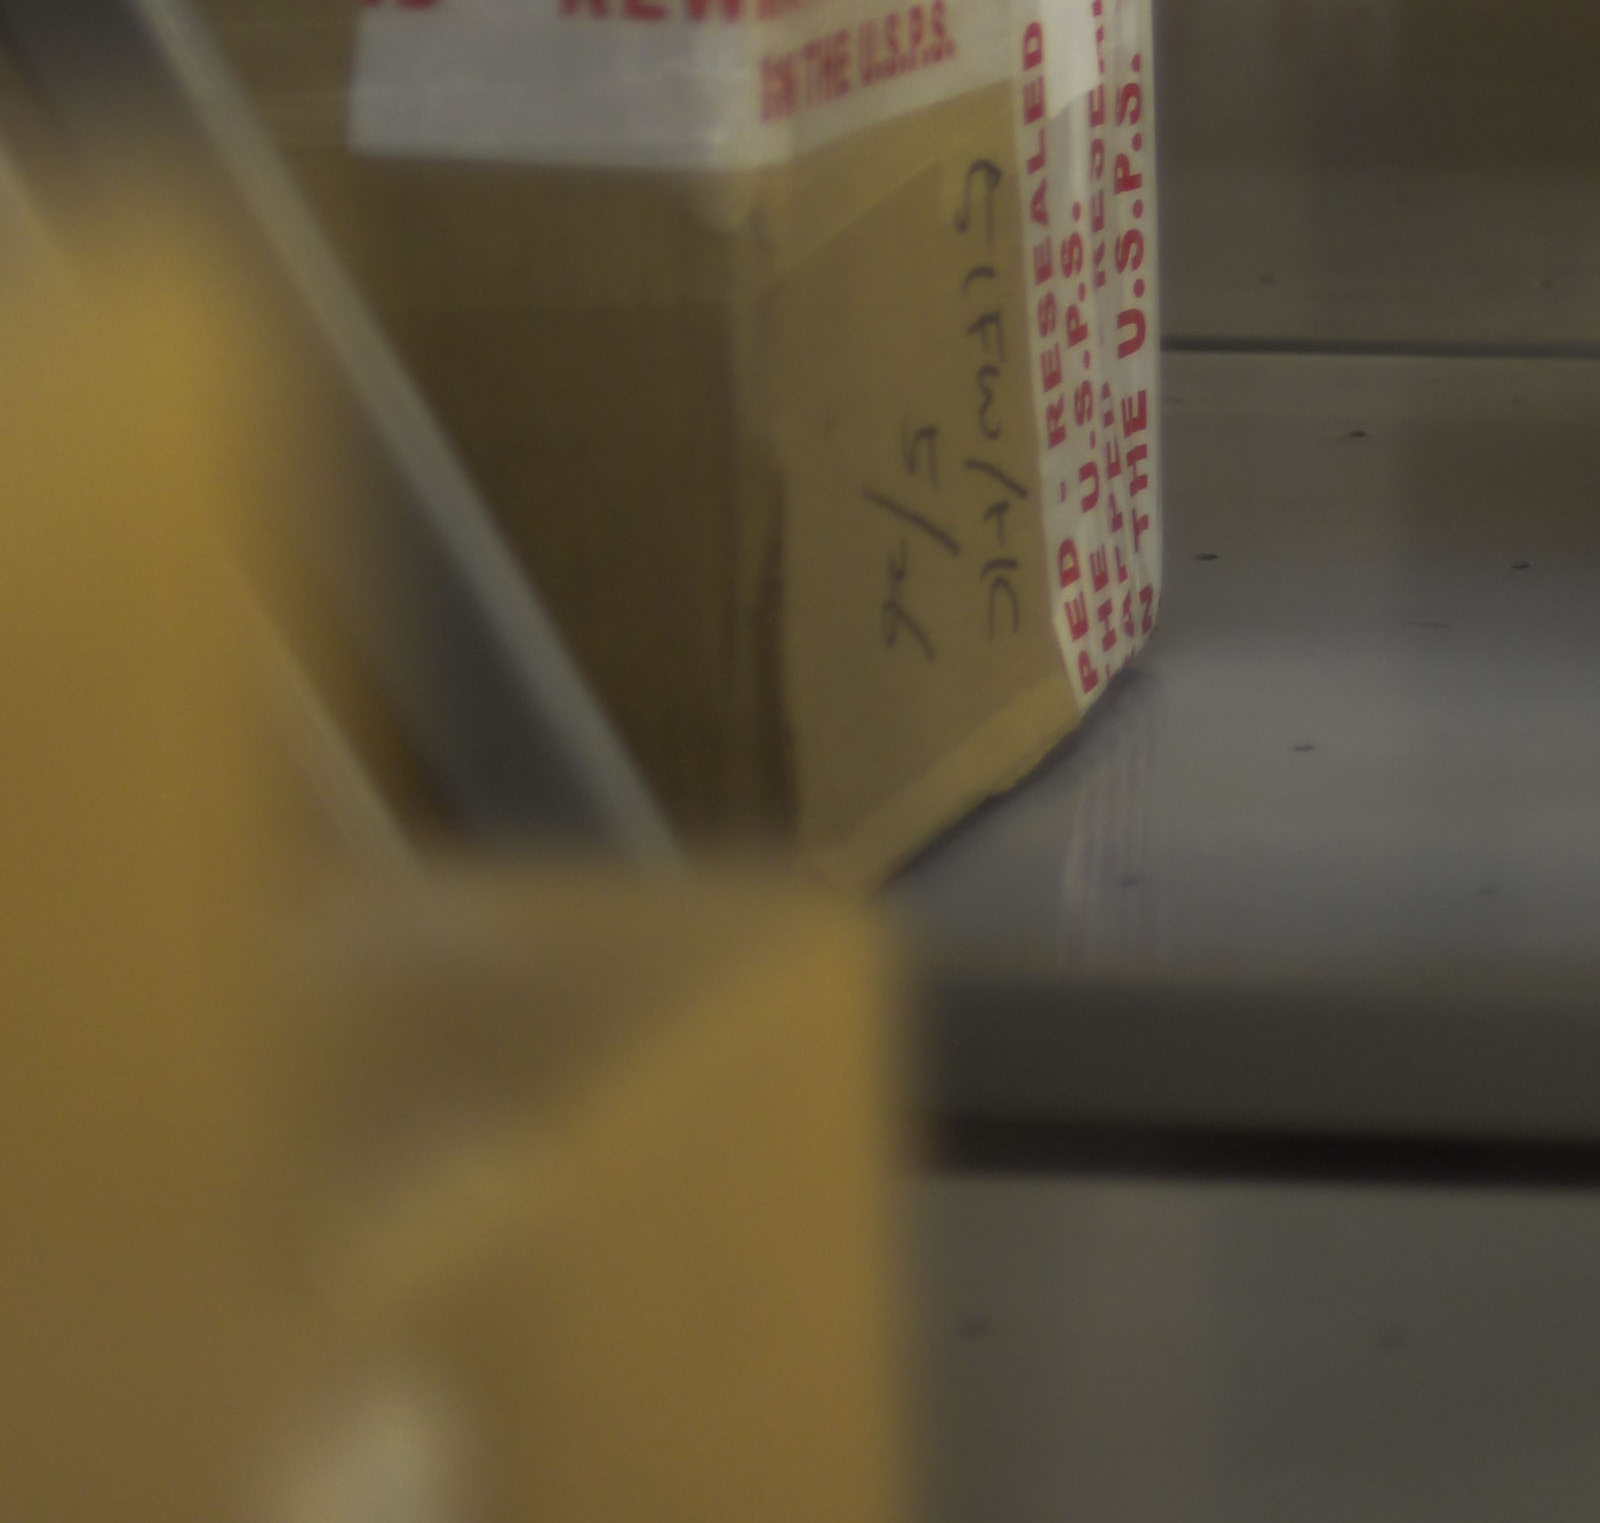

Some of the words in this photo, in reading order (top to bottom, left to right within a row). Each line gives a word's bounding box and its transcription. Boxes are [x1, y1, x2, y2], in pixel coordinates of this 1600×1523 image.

[1022, 19, 1068, 450] RESEALED
[1060, 200, 1100, 514] U.S.P.S.
[1115, 53, 1148, 359] U.S.P.S.
[1122, 389, 1149, 553] THE
